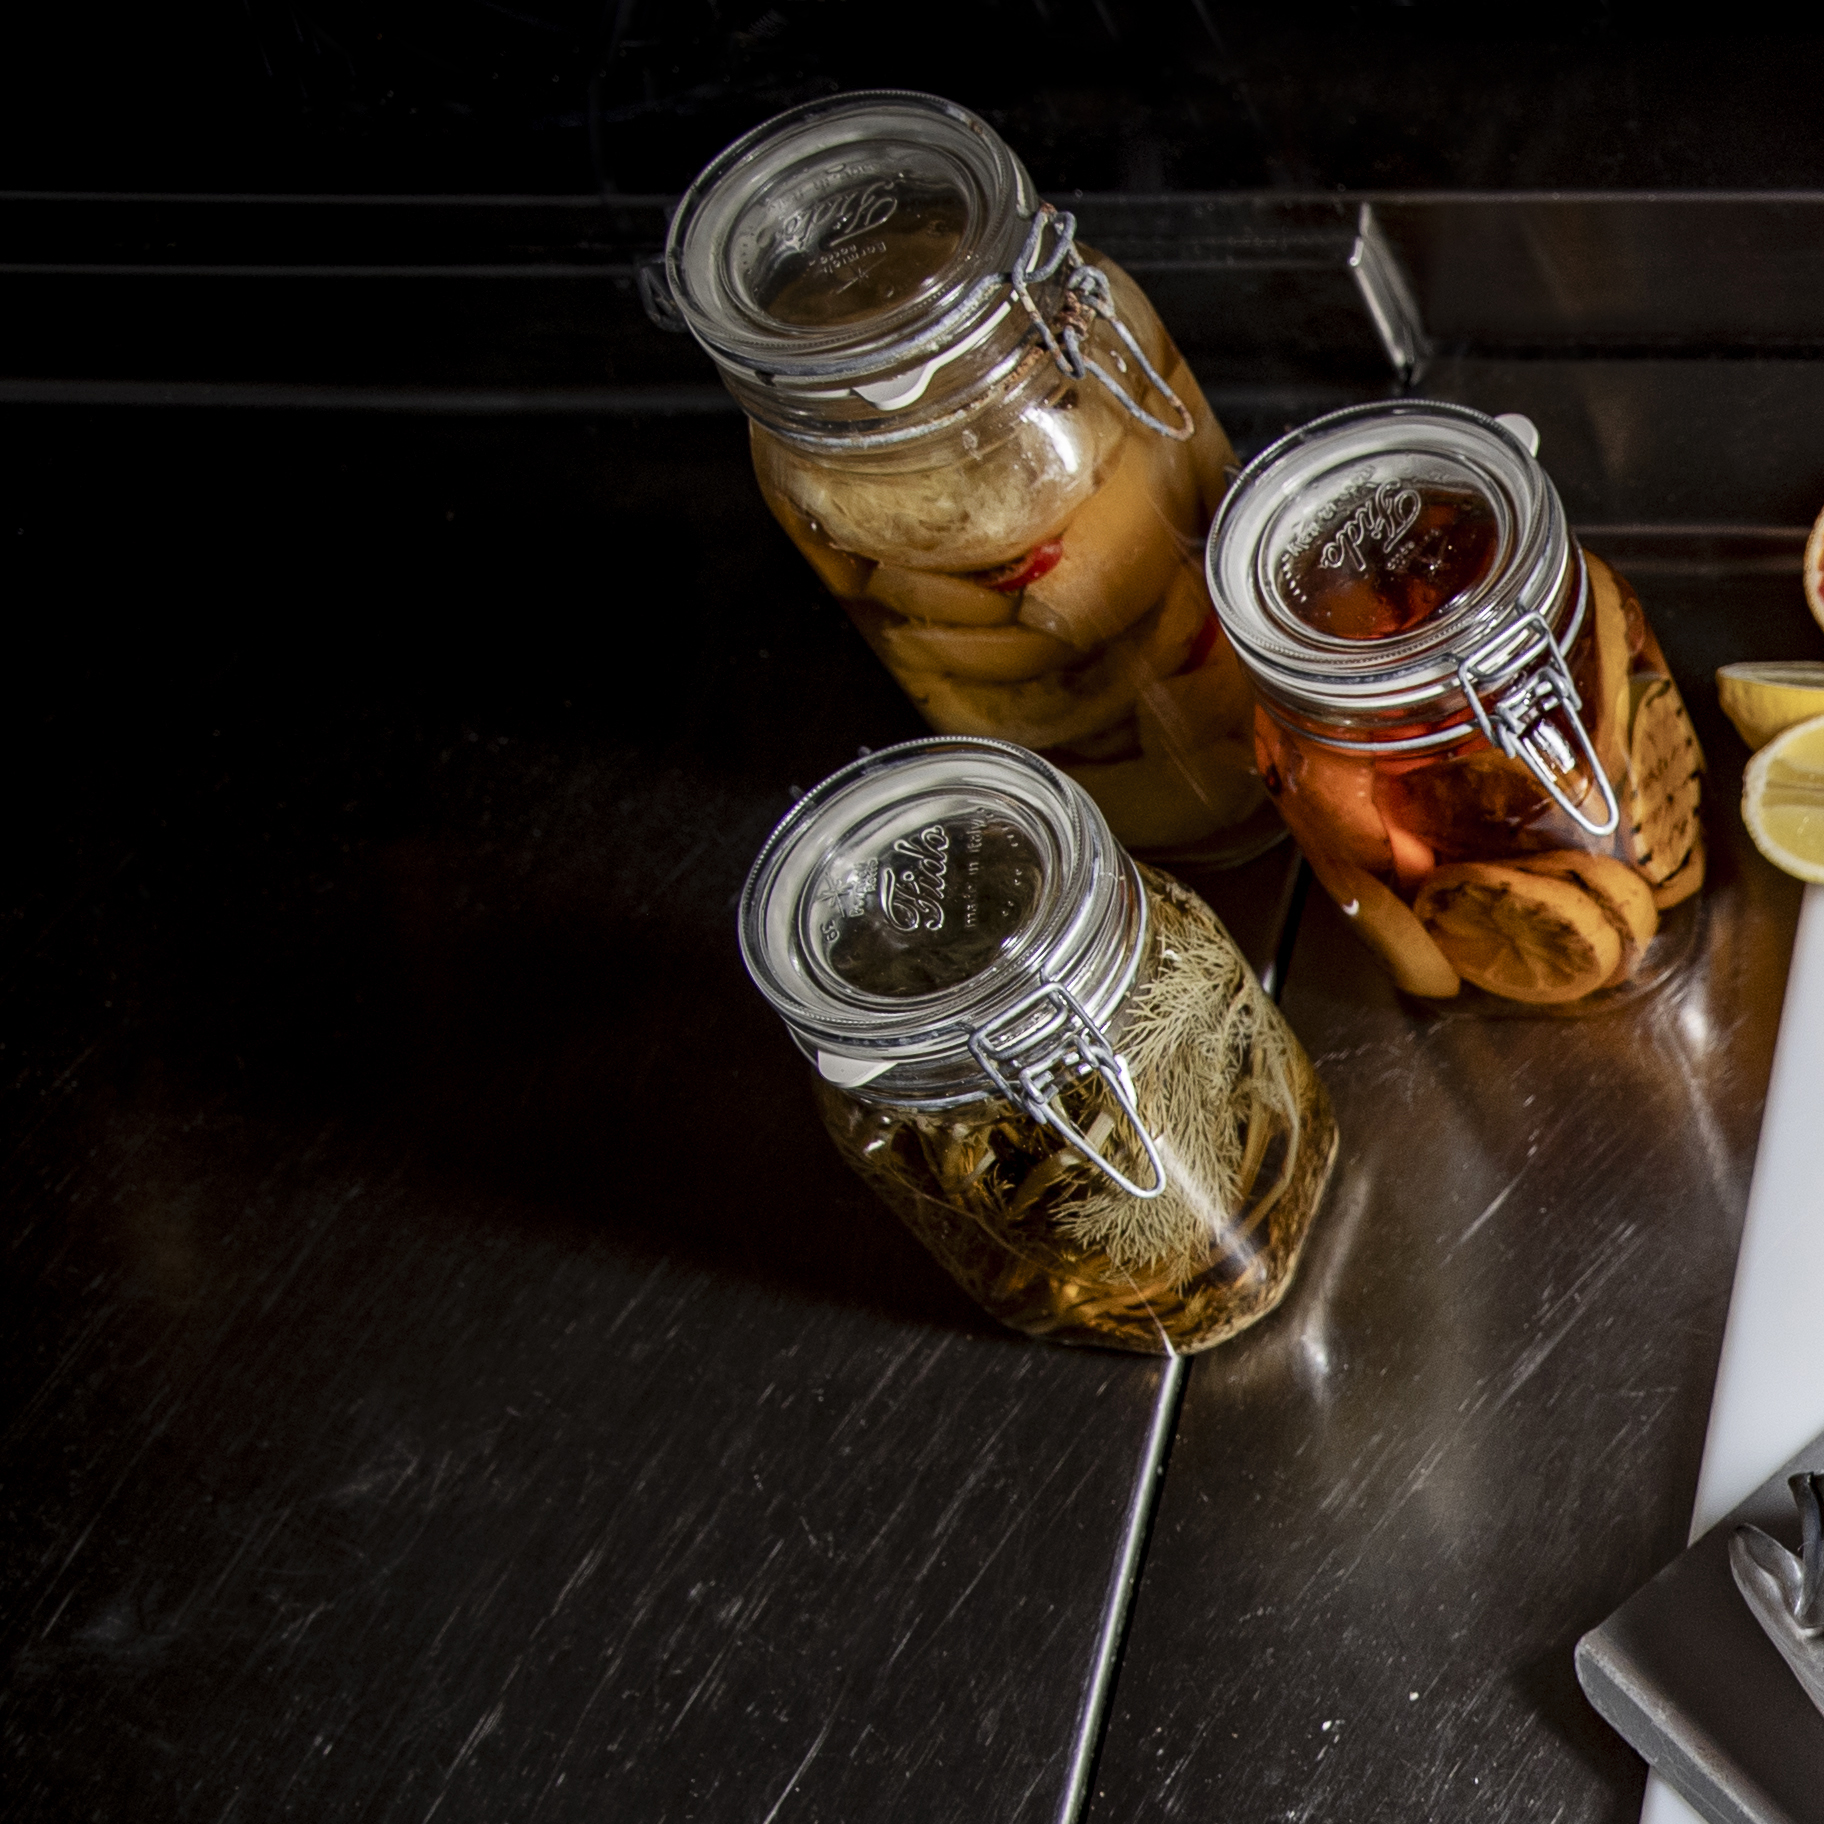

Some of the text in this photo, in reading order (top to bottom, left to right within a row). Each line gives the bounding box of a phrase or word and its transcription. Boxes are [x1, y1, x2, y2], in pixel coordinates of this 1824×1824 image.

[783, 181, 898, 251] Fido
[1319, 480, 1422, 572] Fido
[881, 825, 948, 931] Fido
